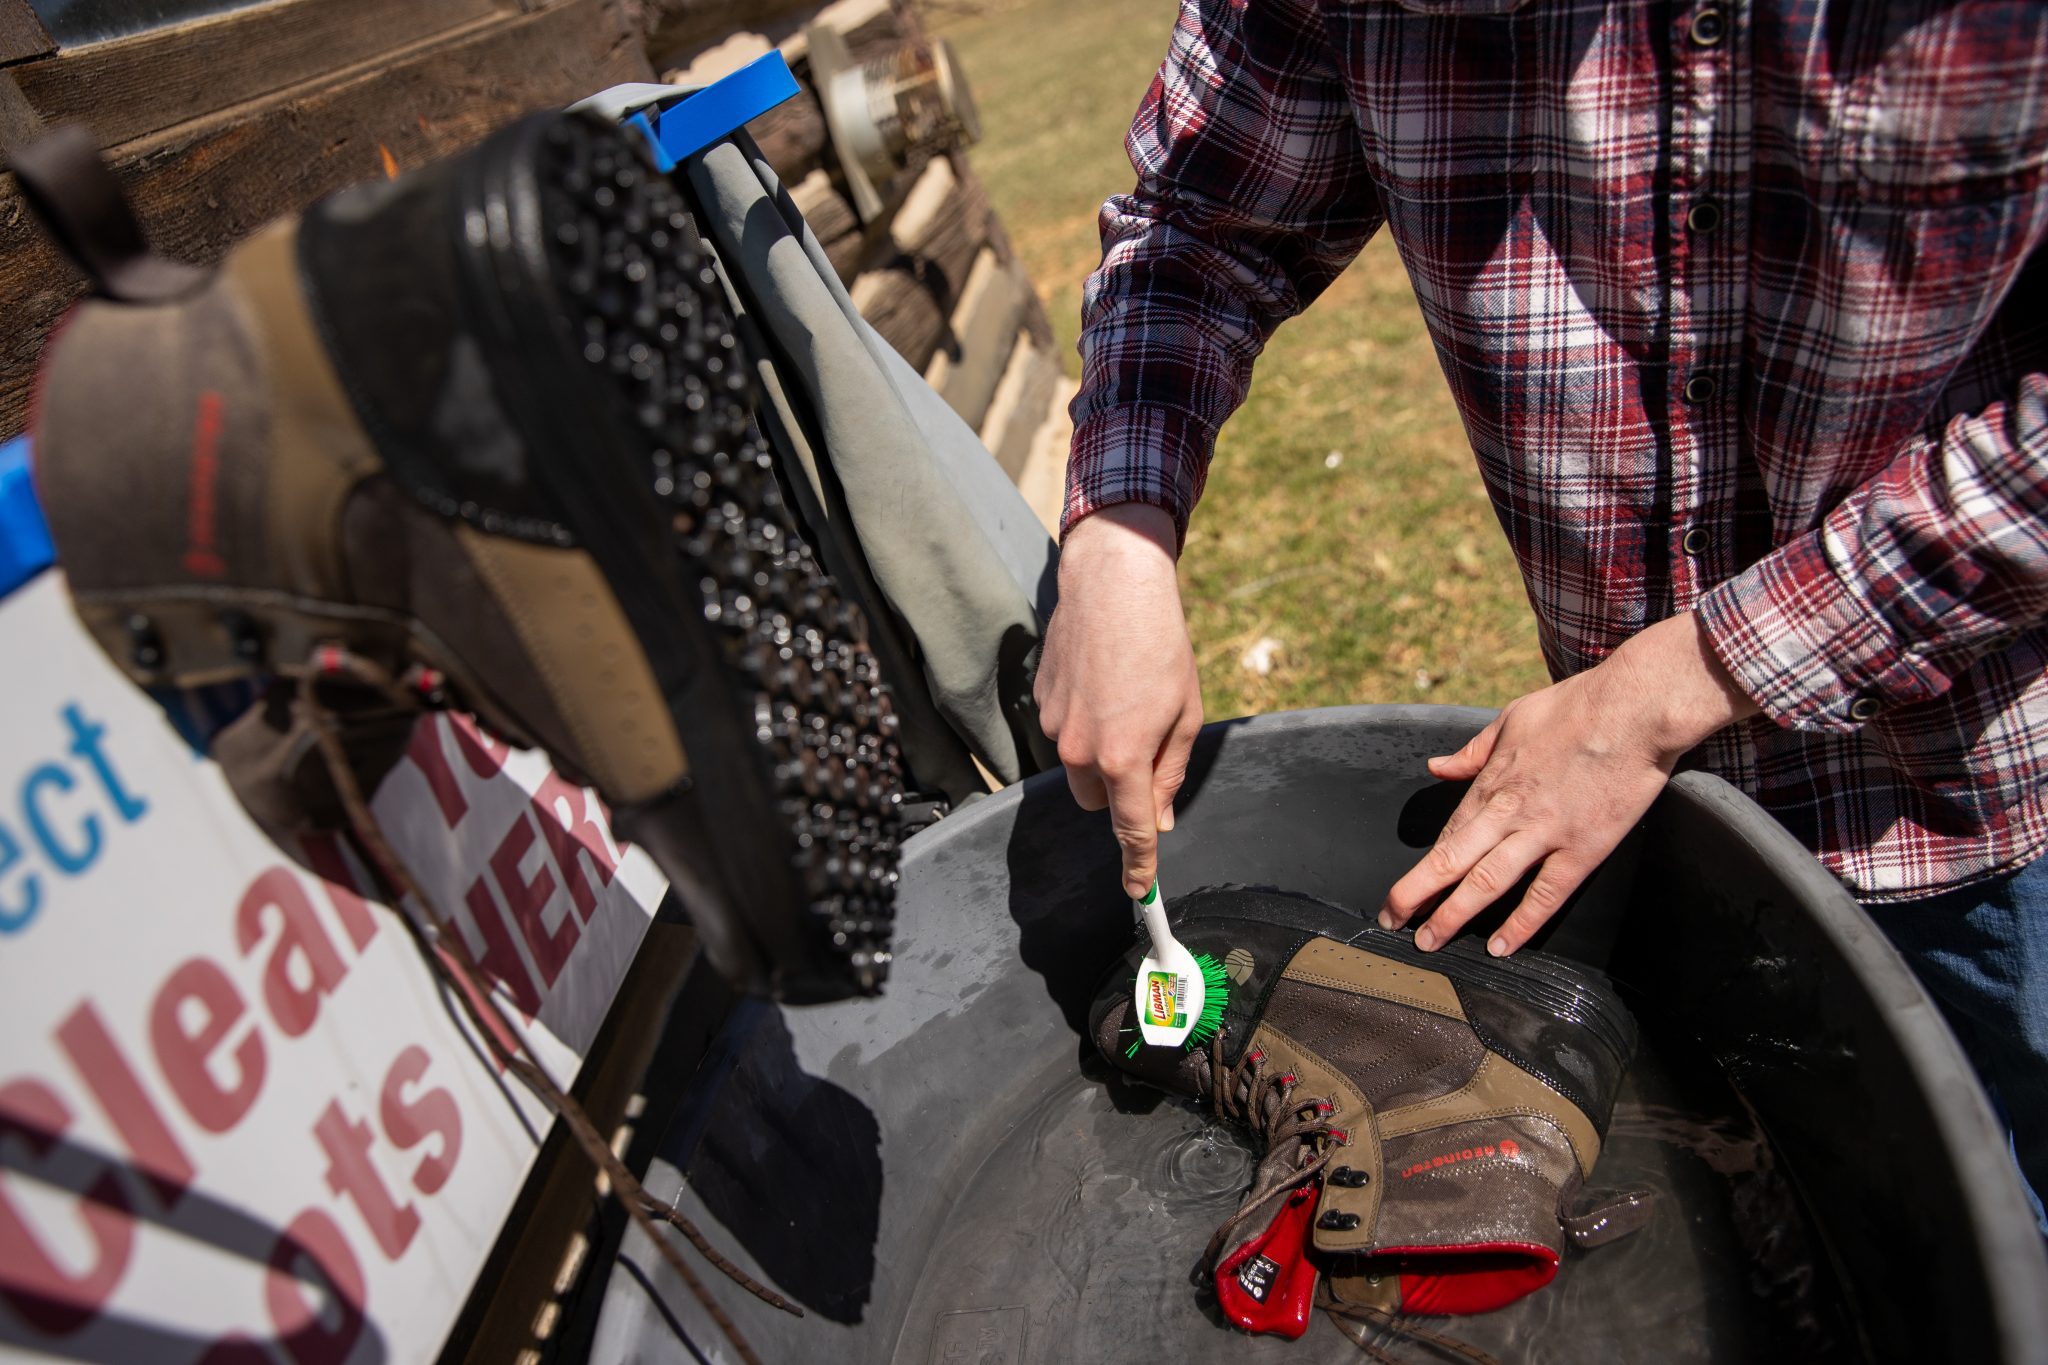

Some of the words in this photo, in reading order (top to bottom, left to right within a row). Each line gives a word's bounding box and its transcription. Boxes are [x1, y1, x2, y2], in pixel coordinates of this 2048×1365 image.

[190, 1043, 463, 1365] ots
[432, 766, 630, 1070] HER
[1151, 979, 1166, 1020] LIBMAN
